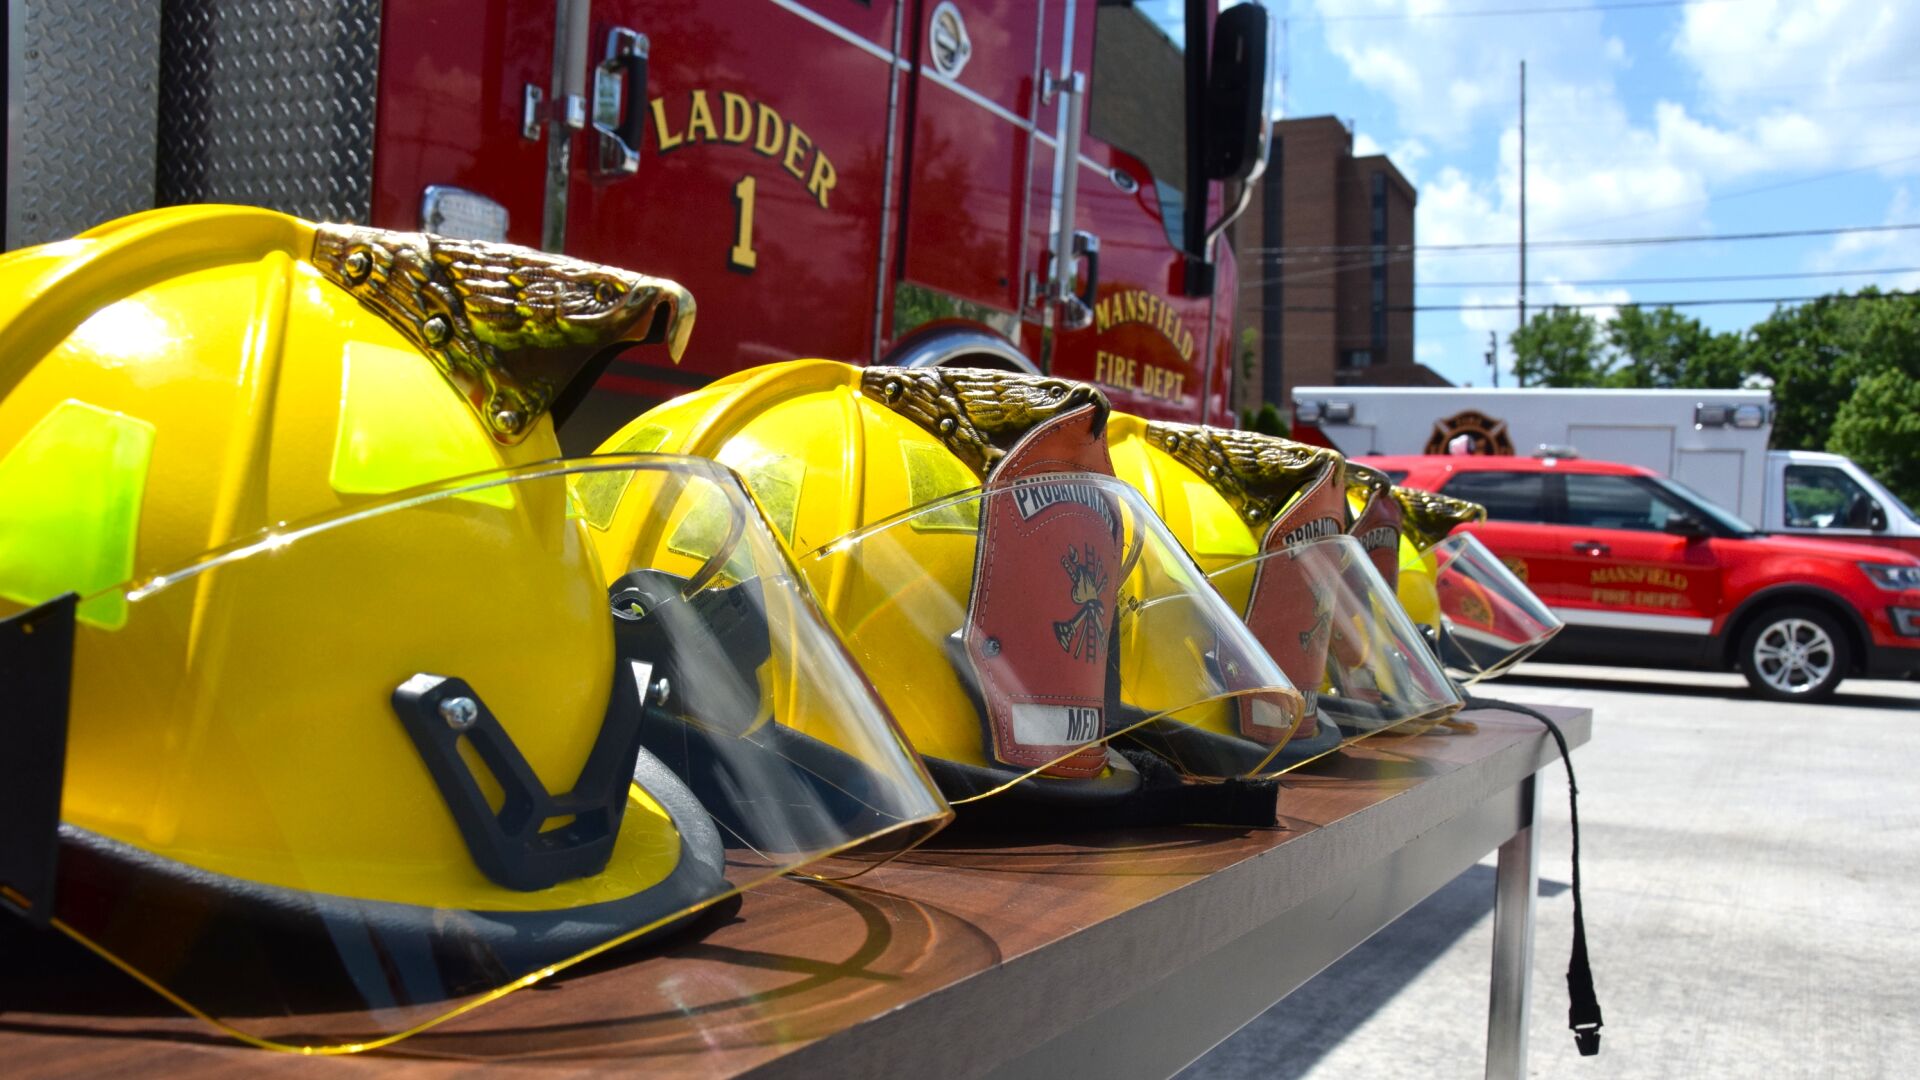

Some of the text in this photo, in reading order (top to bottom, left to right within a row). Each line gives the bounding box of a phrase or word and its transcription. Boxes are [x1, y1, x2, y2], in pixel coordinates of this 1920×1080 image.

[650, 89, 837, 208] LADDER
[731, 175, 757, 271] 1
[1095, 290, 1194, 362] MANSFIELD
[1095, 350, 1185, 404] FIRE DEPT
[1590, 567, 1688, 591] MANSFIELD
[1592, 588, 1631, 605] FIRE
[1066, 708, 1096, 742] MFD
